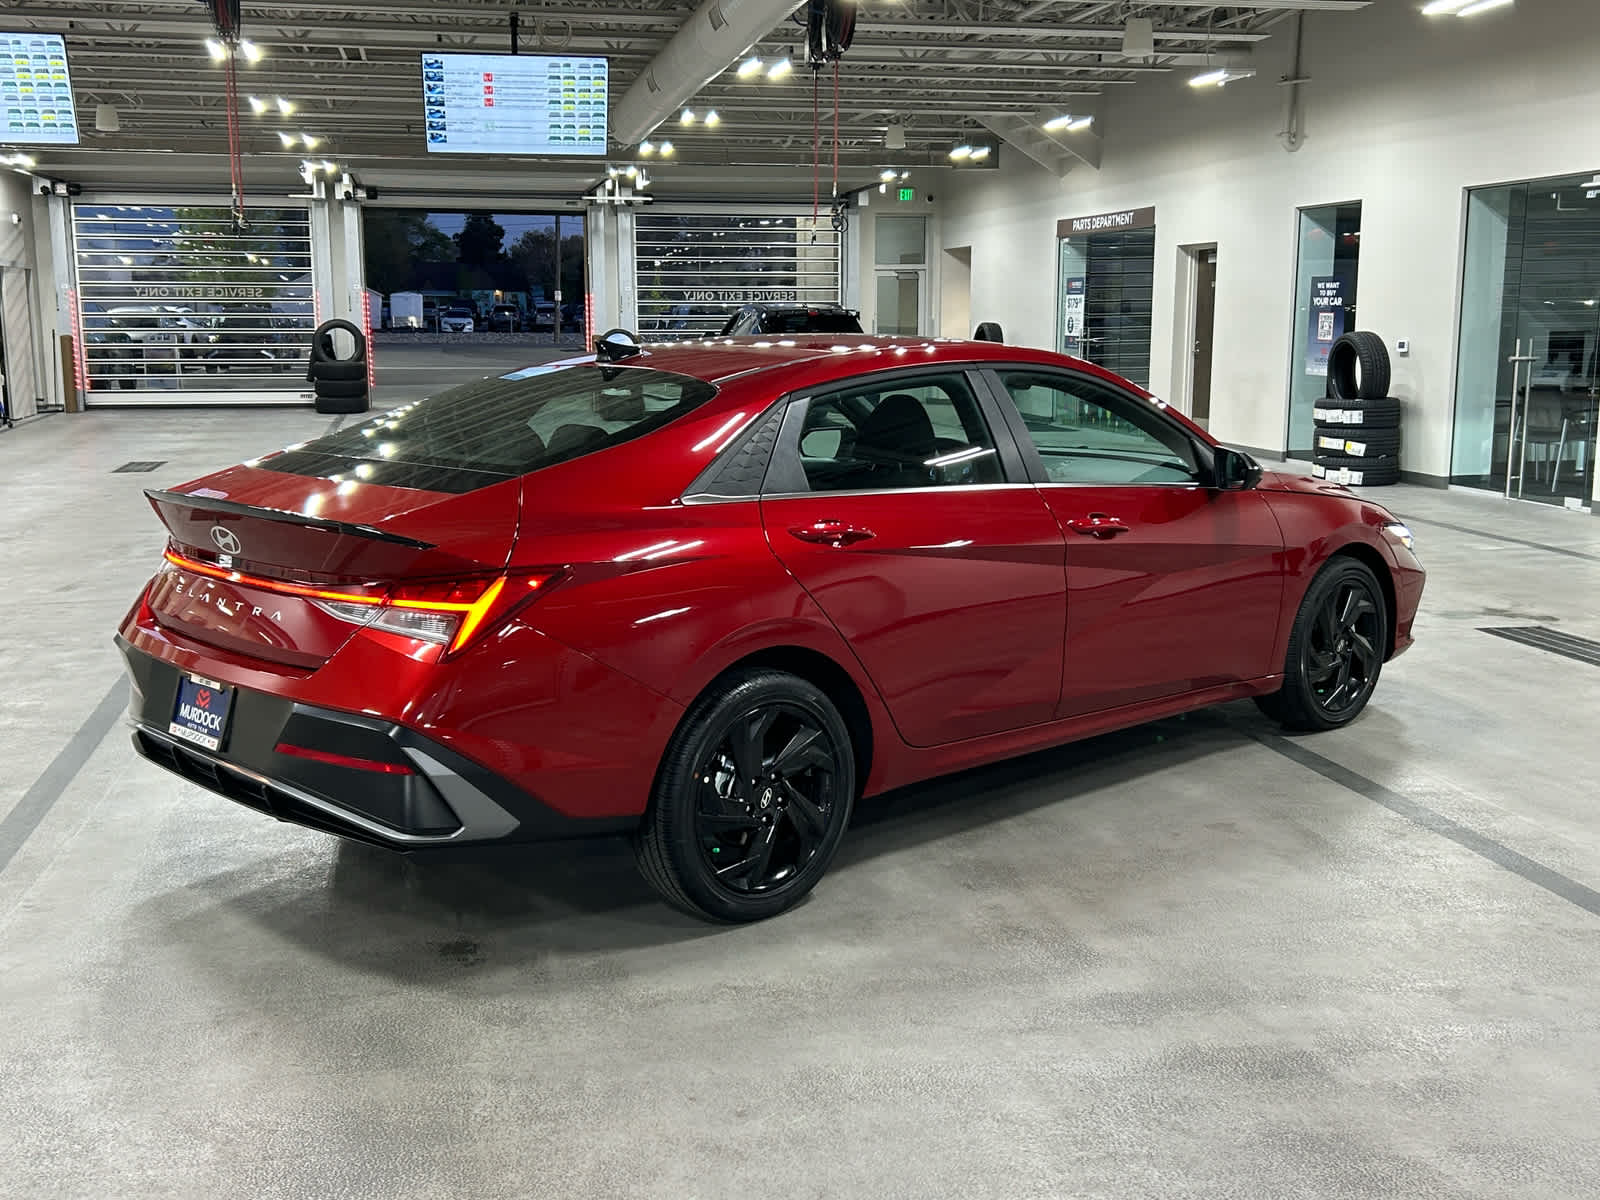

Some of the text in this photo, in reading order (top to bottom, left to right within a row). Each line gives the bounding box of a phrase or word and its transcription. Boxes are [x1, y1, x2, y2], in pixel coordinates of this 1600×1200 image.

[899, 188, 913, 201] EXIT
[1072, 212, 1134, 231] PARTS DEPARTMENT
[1313, 297, 1343, 306] YOUR CAR
[175, 584, 281, 621] ELANTRA
[180, 702, 222, 731] MURDOCK
